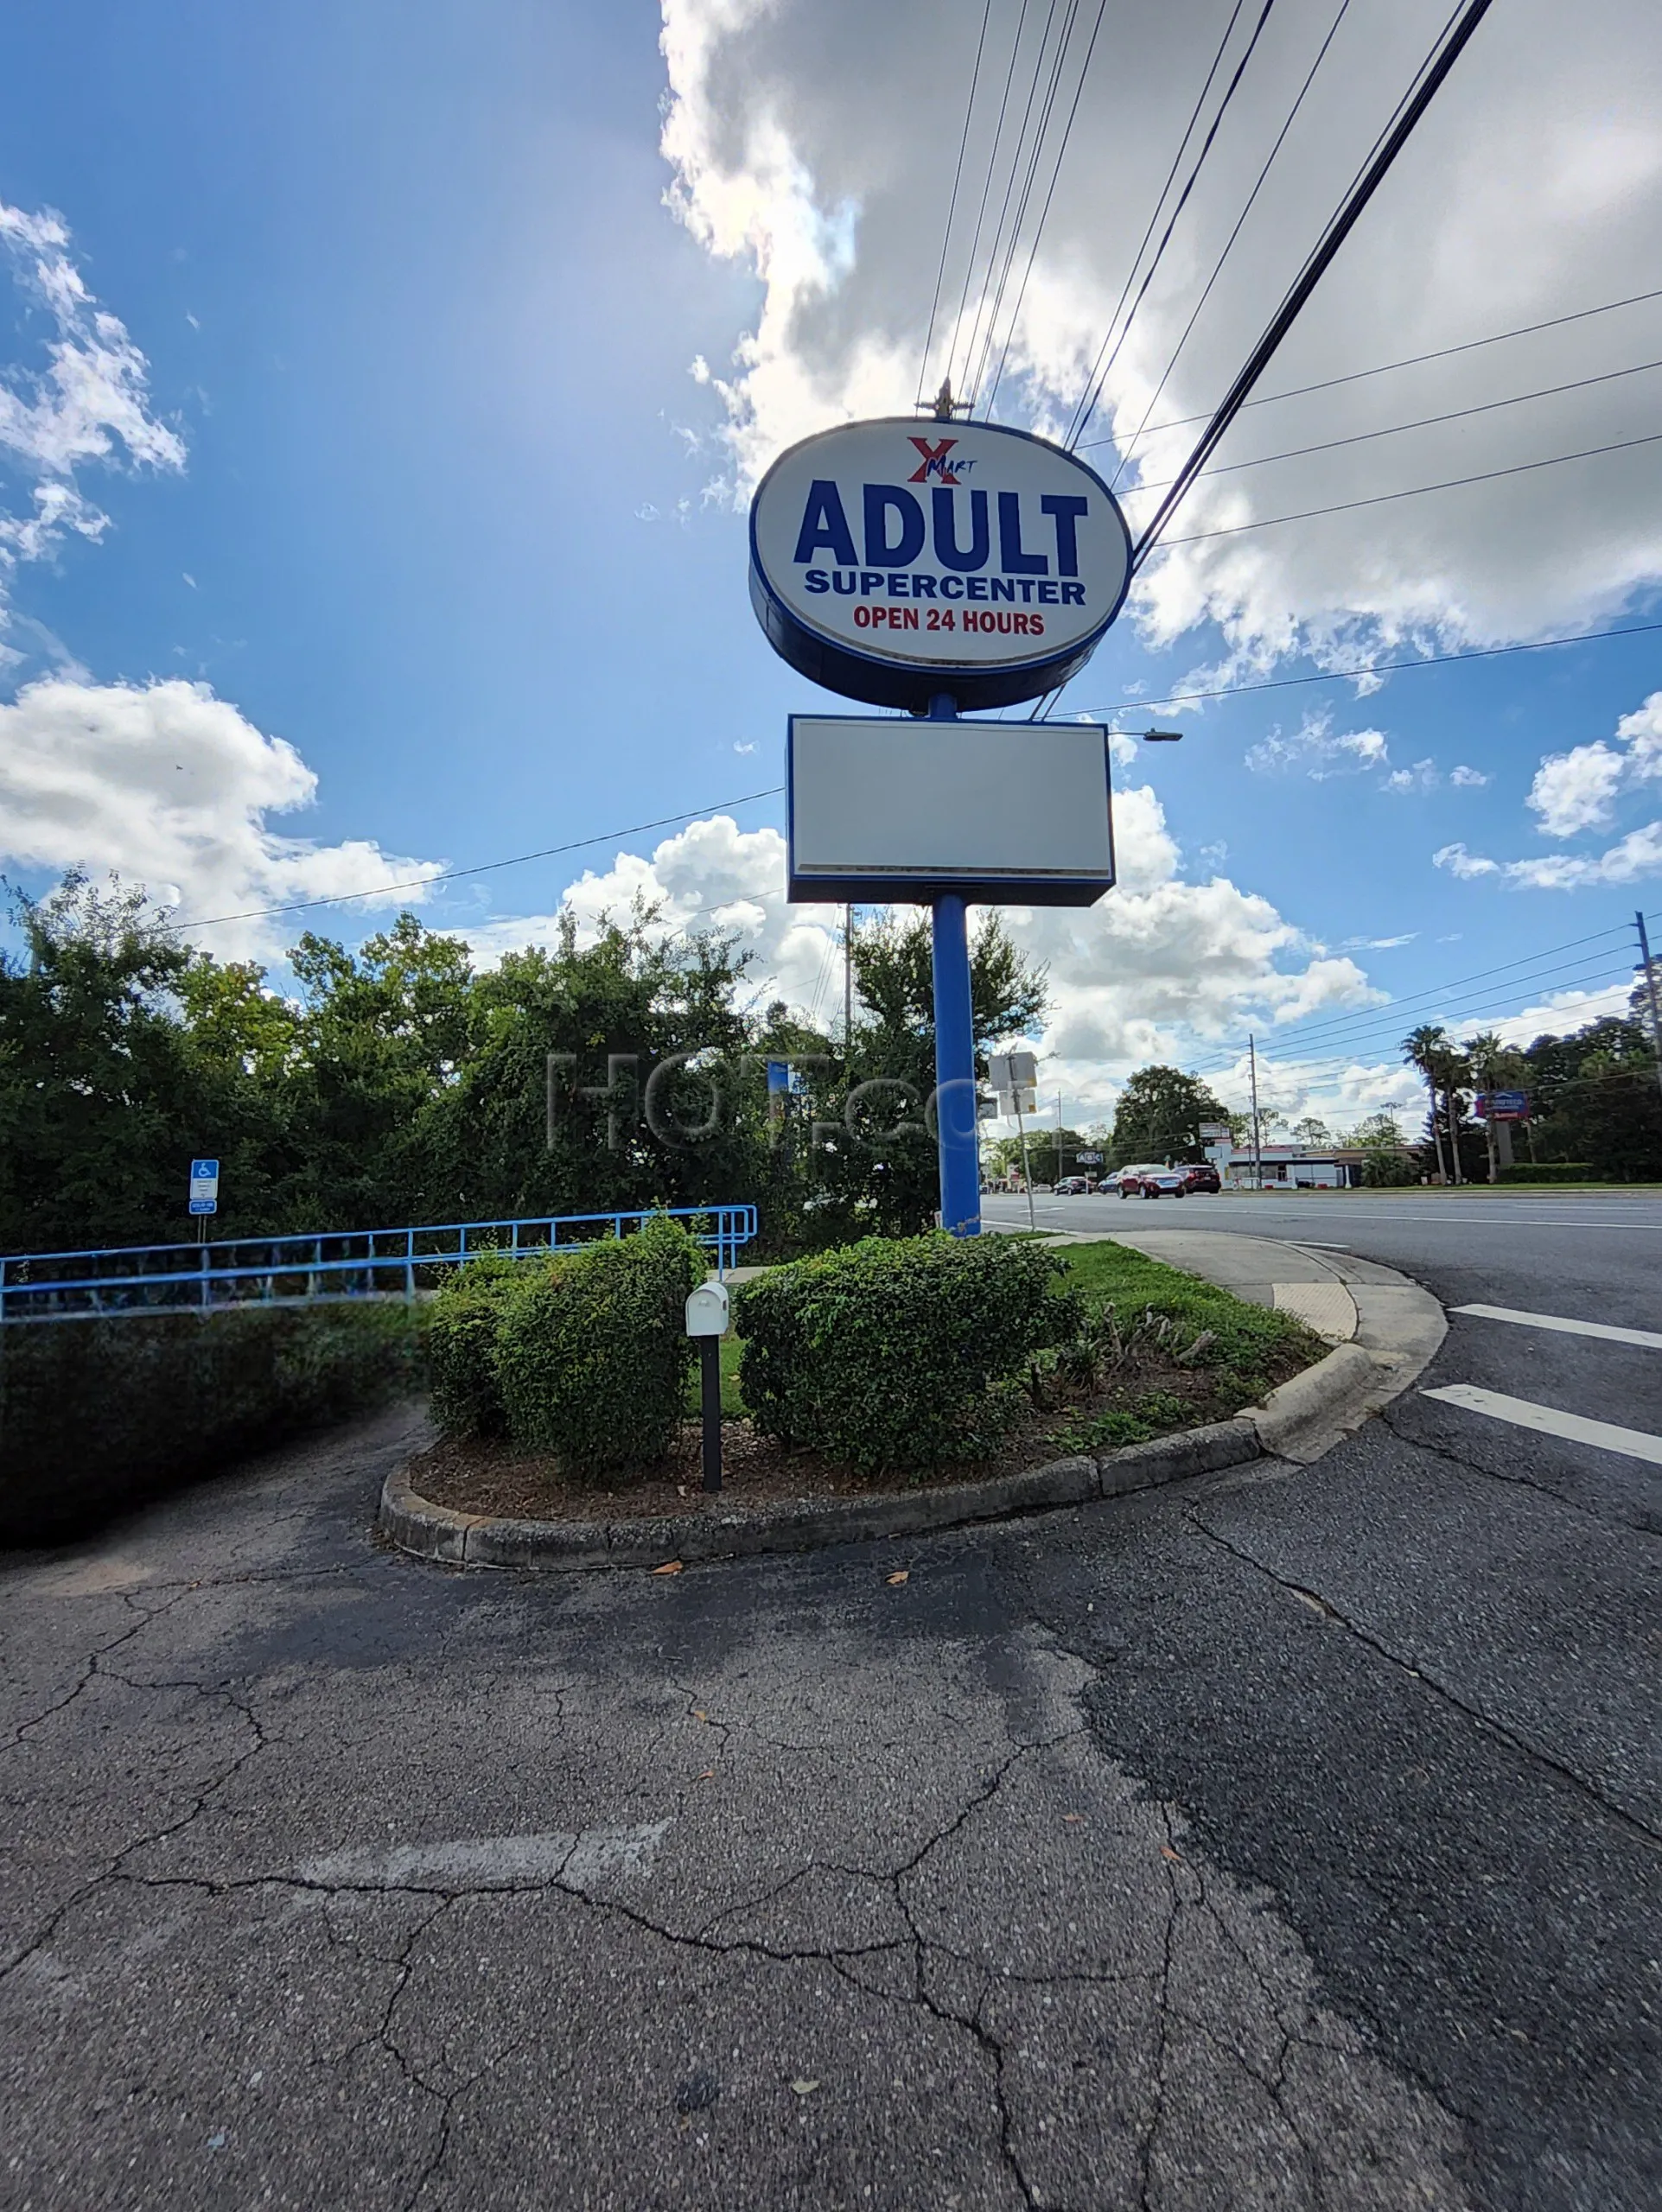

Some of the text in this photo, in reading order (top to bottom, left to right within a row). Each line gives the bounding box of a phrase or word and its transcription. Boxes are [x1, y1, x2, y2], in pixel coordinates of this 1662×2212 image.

[907, 436, 961, 485] X
[793, 479, 1088, 577] ADULT
[805, 570, 1086, 605] SUPERCENTER
[854, 606, 1044, 635] OPEN 24 HOURS
